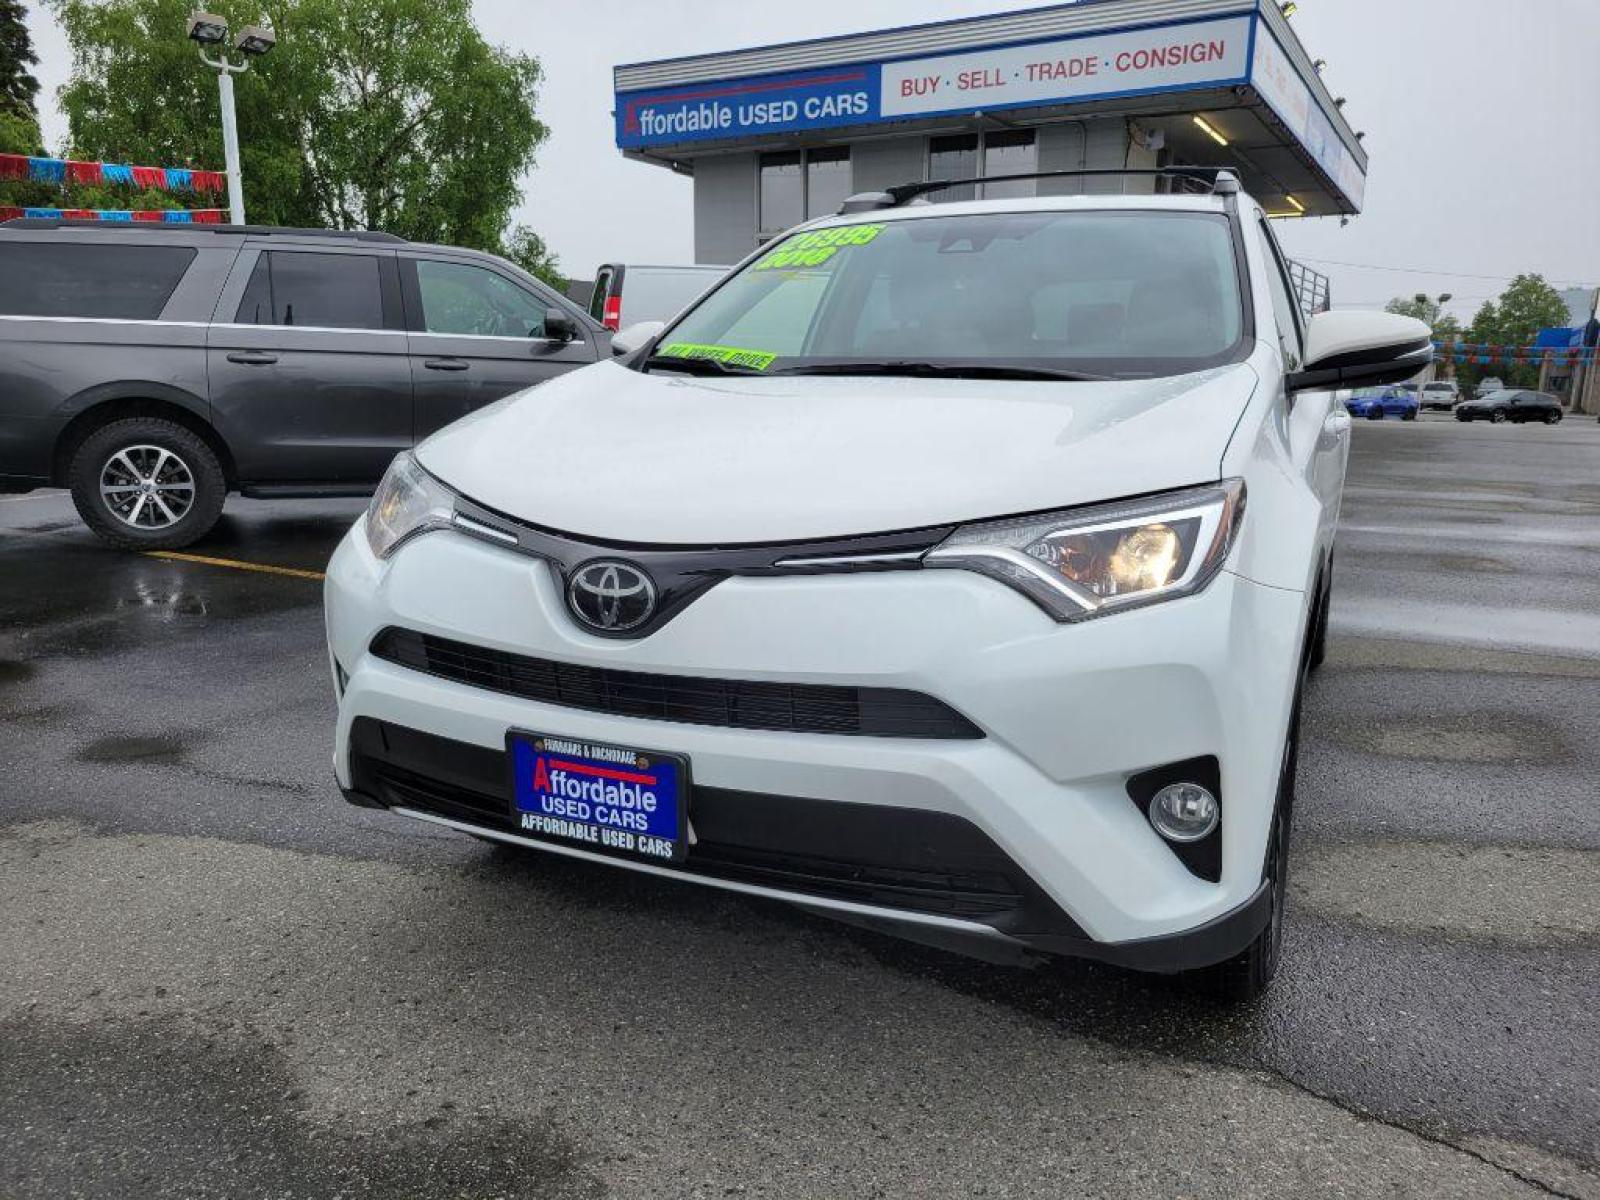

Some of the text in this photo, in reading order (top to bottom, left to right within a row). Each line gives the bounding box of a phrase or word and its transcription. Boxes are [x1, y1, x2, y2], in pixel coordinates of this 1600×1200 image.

[901, 40, 1226, 98] BUY SELL TRADE CONSIGN
[623, 91, 869, 137] Affordable USED CARS
[534, 757, 657, 812] Affordable
[541, 794, 648, 831] USED CARS
[521, 813, 673, 859] AFFORDABLE USED CARS
